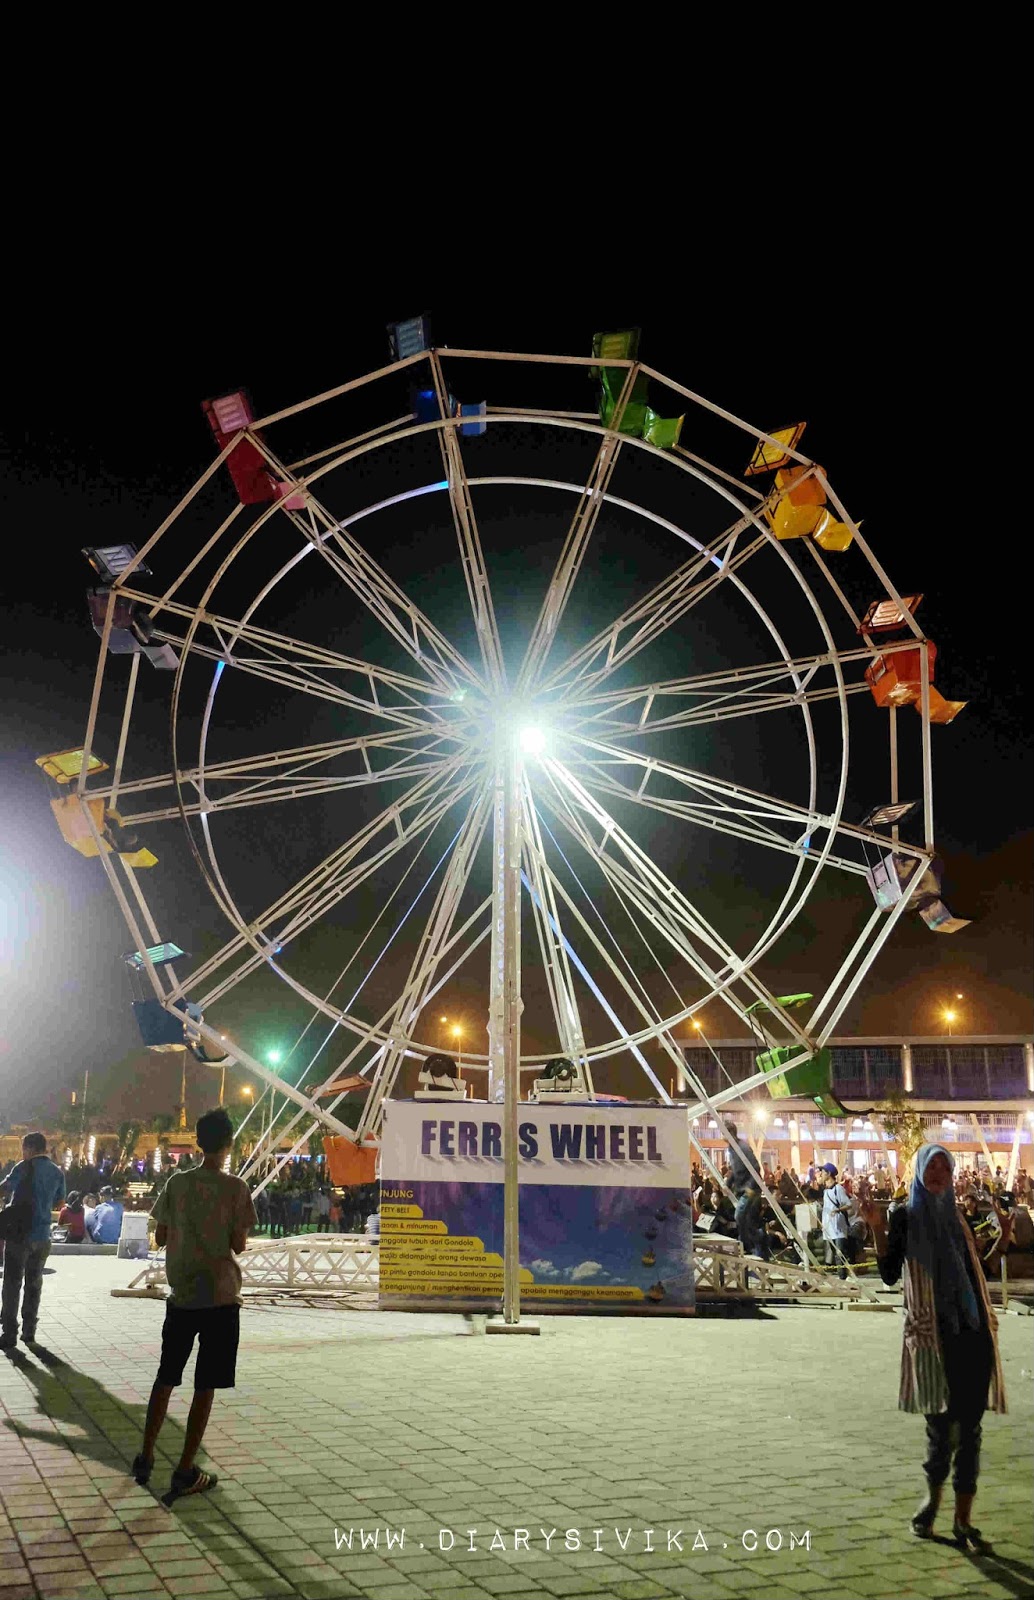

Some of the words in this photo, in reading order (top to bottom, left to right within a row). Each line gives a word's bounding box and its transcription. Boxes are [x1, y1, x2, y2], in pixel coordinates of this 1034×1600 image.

[421, 1120, 538, 1158] FERRS
[550, 1124, 662, 1160] WHEEL
[399, 1253, 436, 1261] didampingi
[385, 1284, 425, 1292] pengunjung
